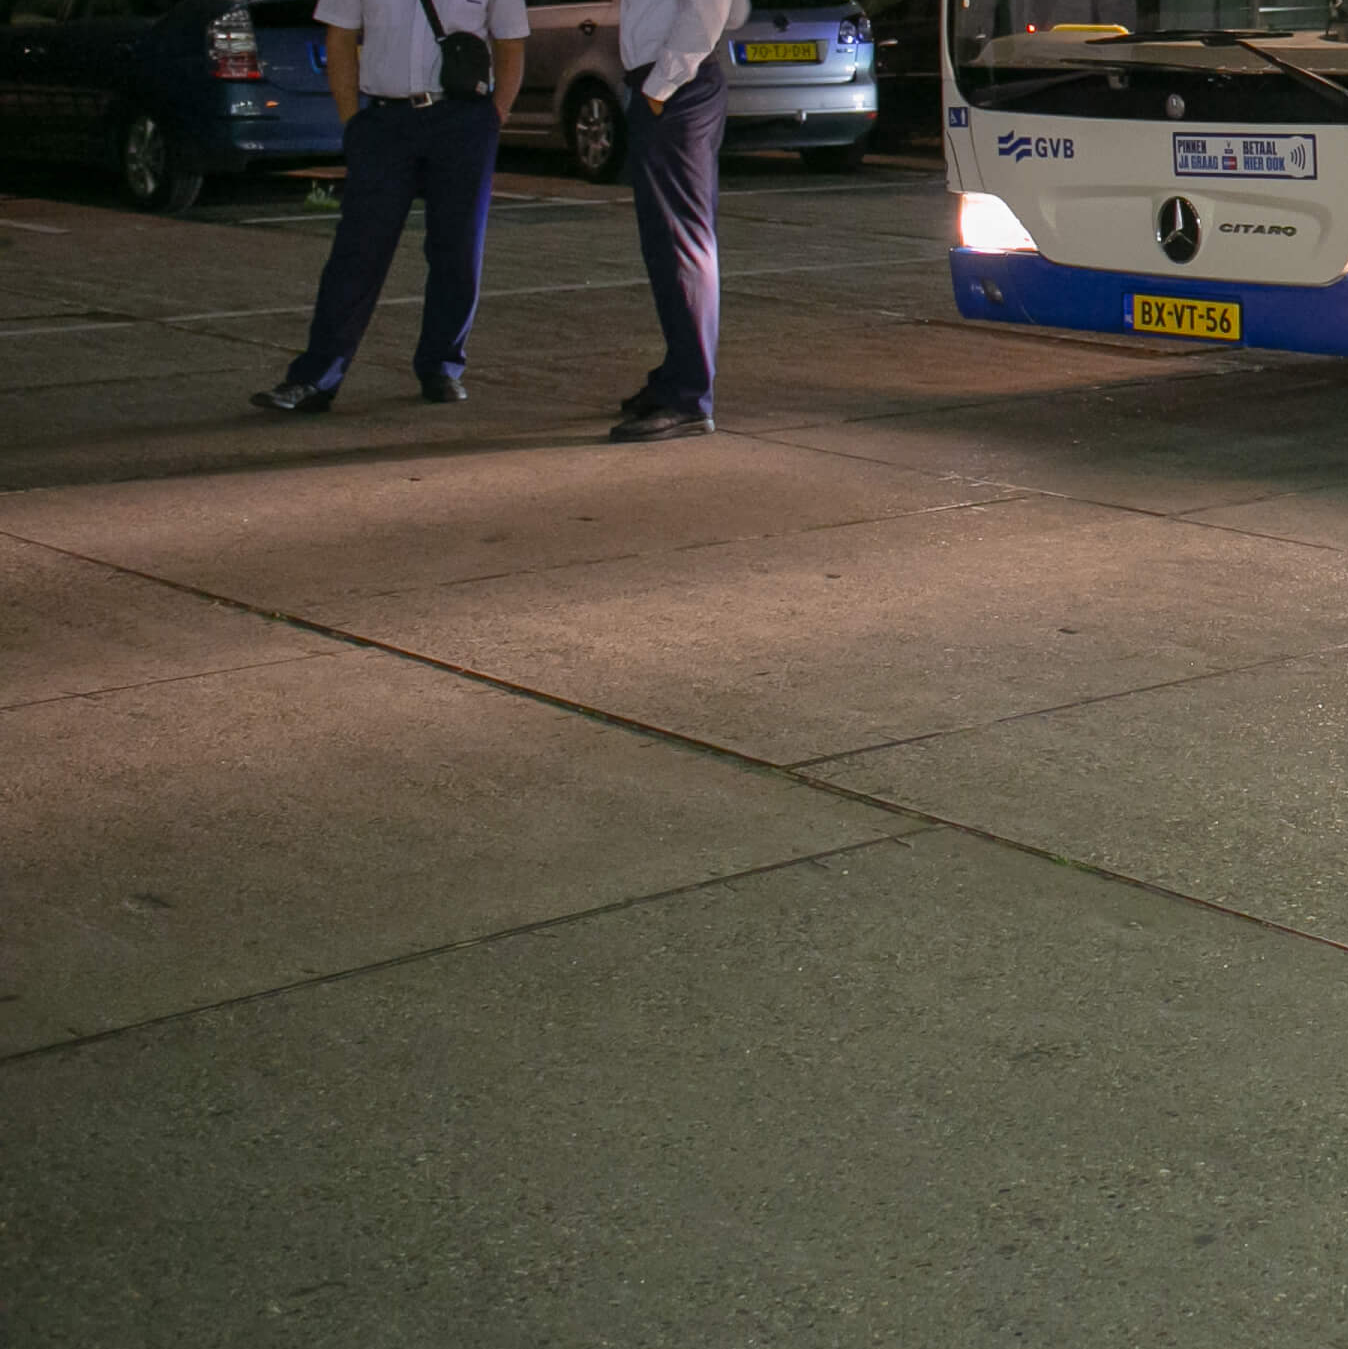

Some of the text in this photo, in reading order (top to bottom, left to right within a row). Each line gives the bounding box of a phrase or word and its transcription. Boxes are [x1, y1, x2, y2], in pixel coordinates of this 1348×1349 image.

[1035, 137, 1074, 159] GVB
[1242, 141, 1278, 156] BETAAL
[1243, 156, 1265, 171] HIER
[1218, 222, 1298, 237] CITARO
[1141, 300, 1232, 334] BX-VT-56
